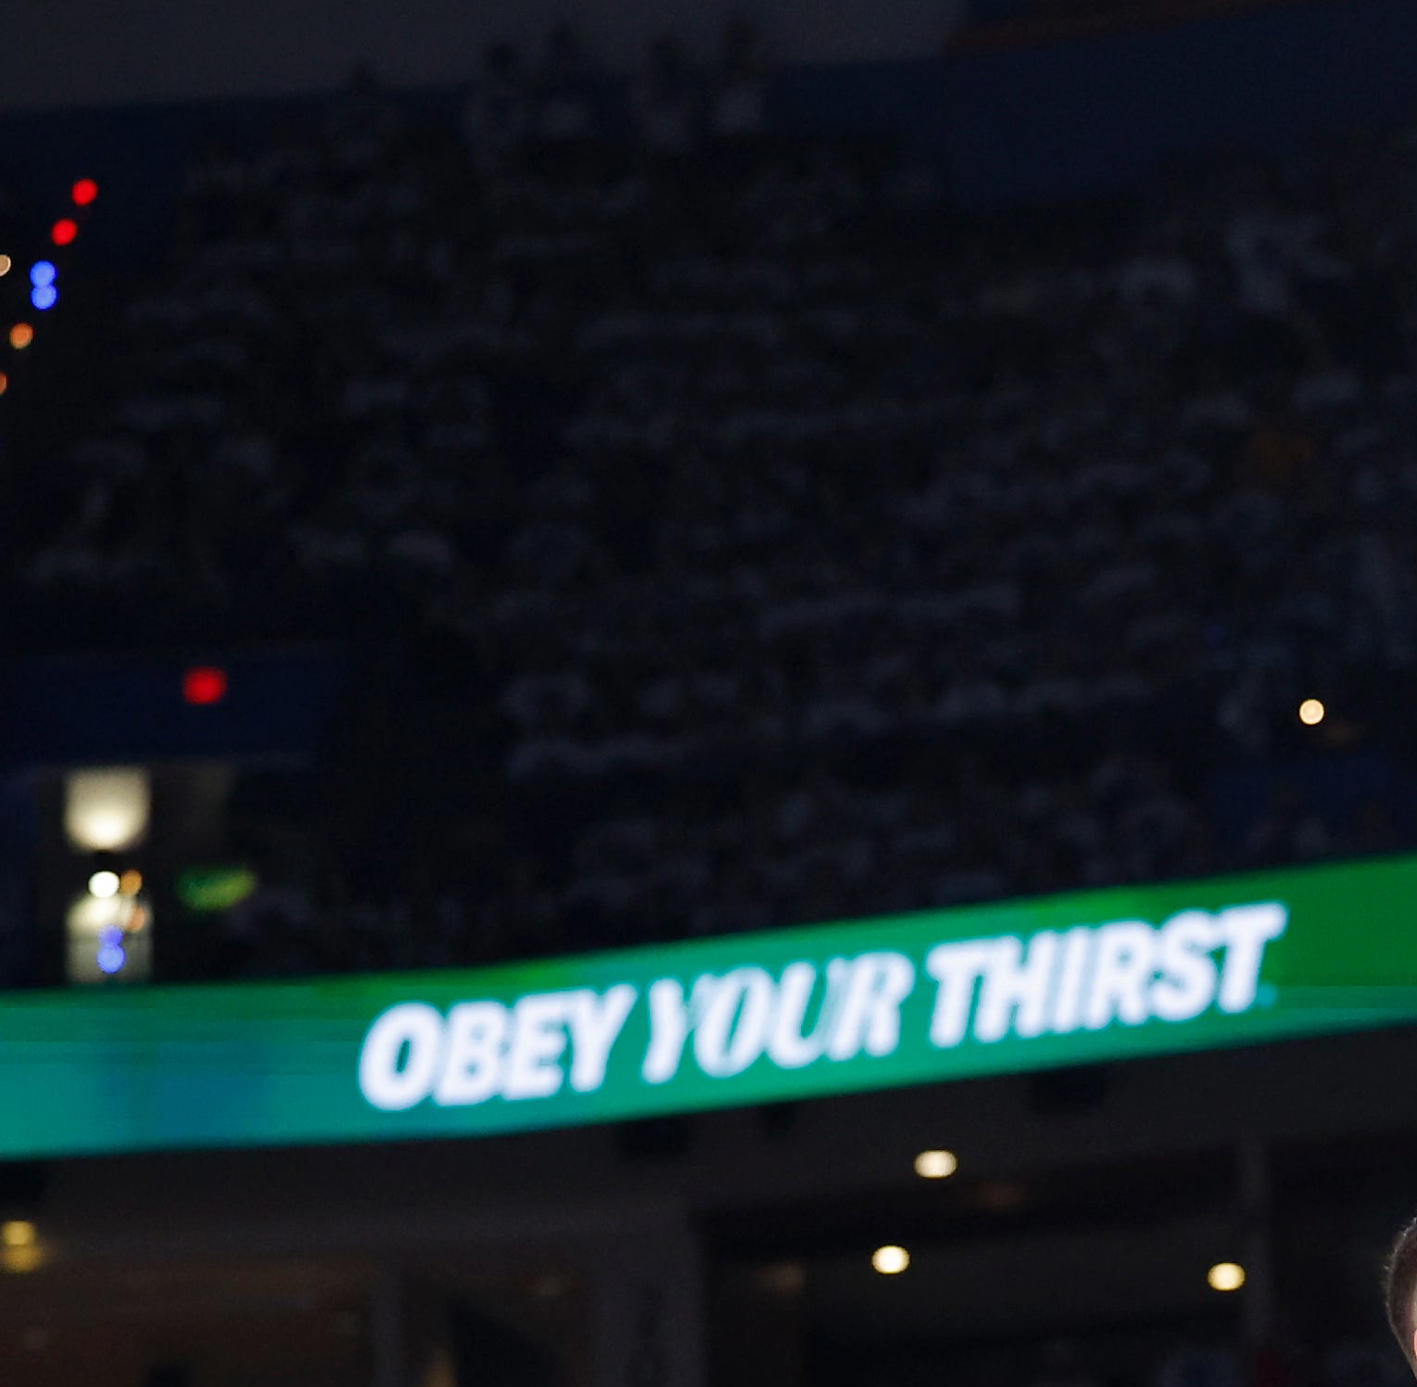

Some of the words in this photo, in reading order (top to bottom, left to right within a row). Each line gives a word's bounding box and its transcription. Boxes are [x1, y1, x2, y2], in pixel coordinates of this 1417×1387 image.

[358, 975, 638, 1112] OBEY
[640, 950, 914, 1085] YOUR
[924, 901, 1289, 1049] THIRST
